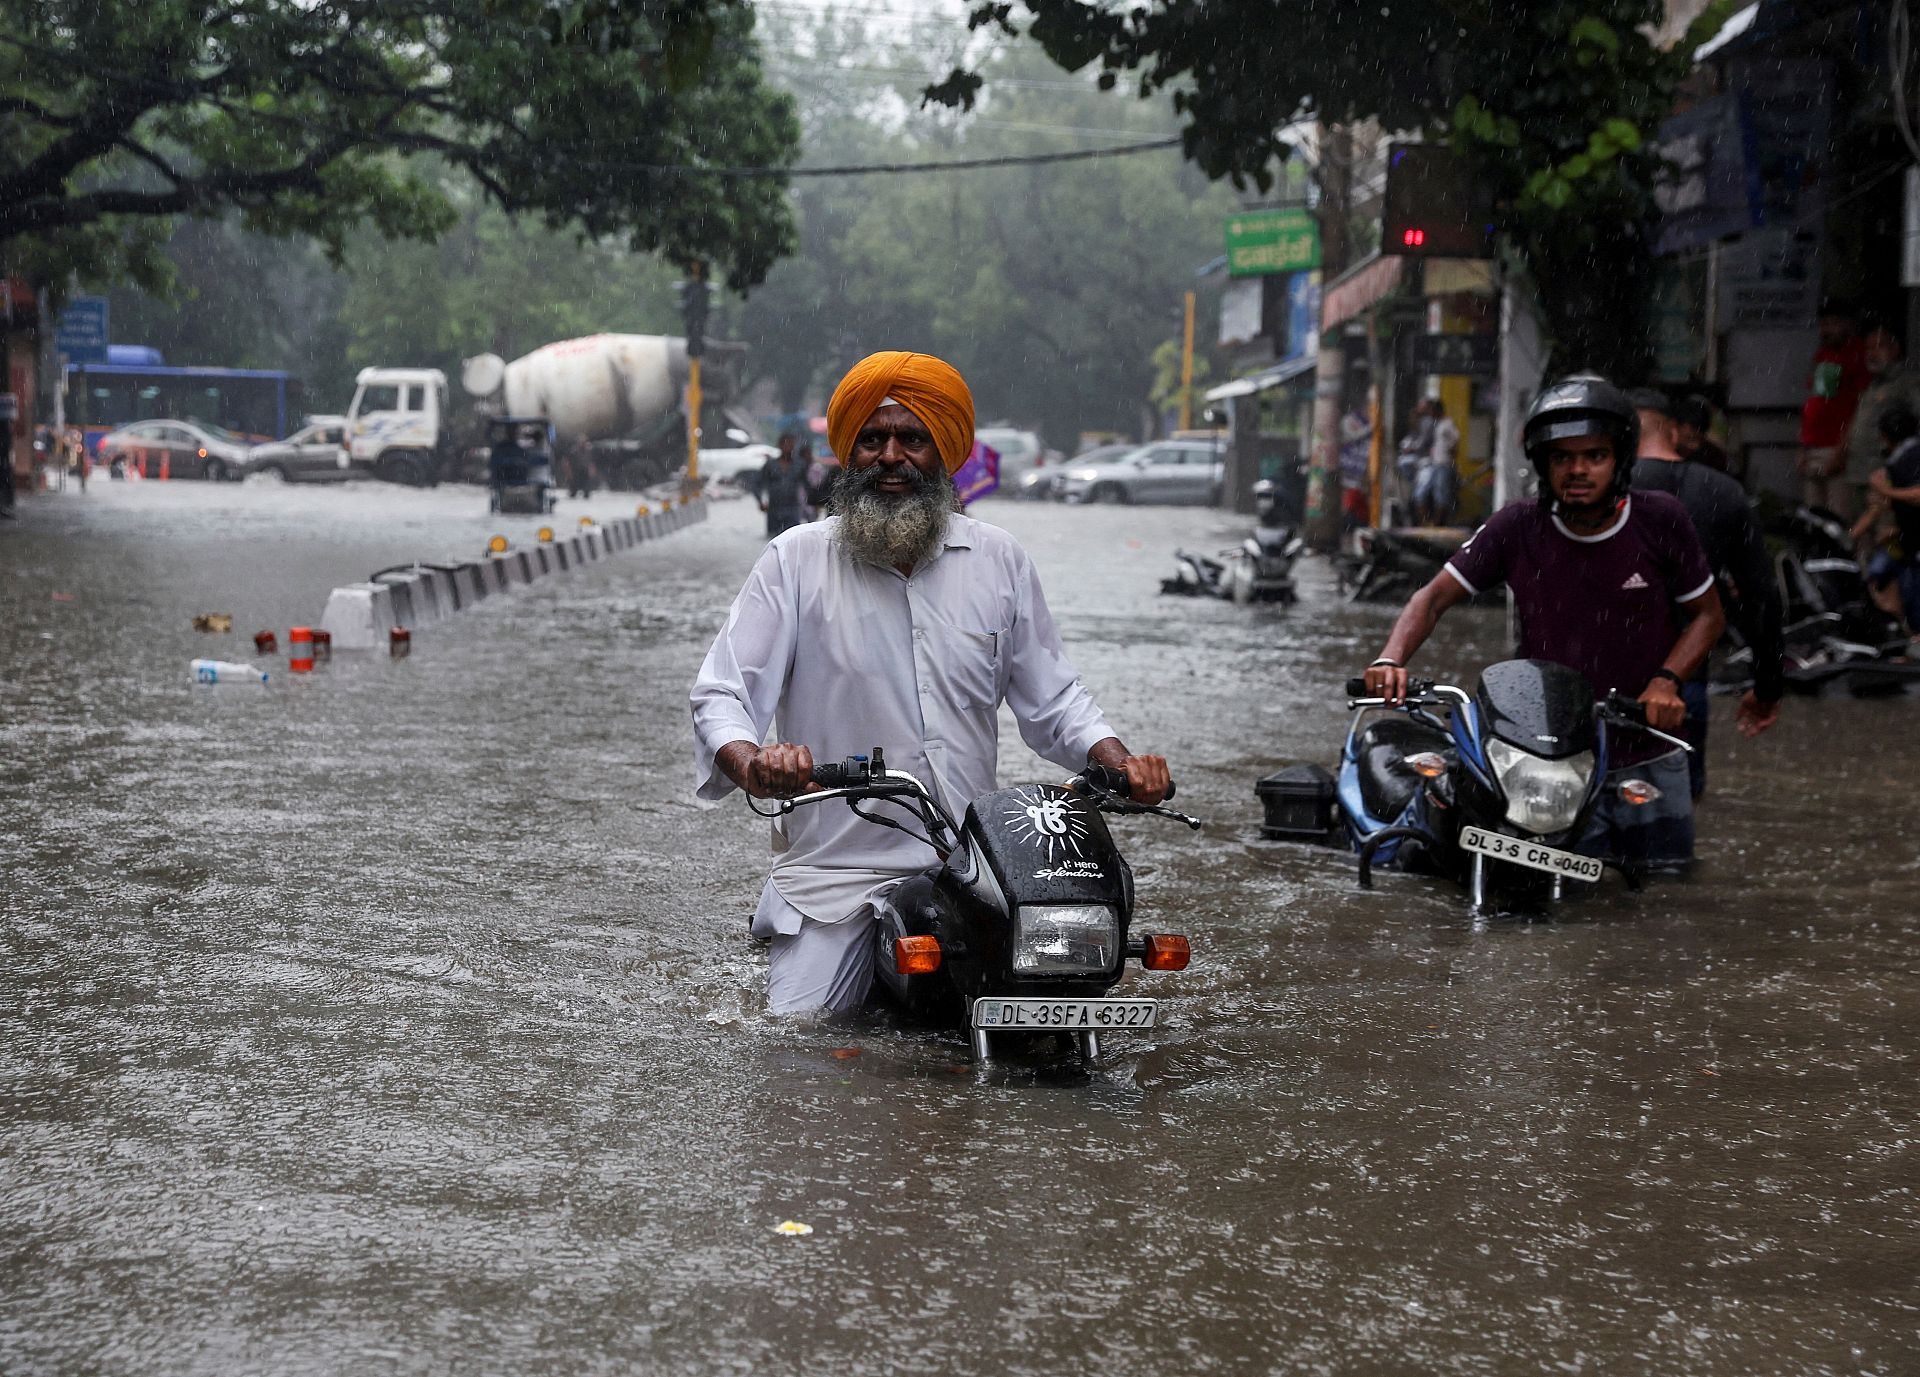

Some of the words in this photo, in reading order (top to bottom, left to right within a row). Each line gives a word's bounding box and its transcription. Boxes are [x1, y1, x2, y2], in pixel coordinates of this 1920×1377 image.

[1467, 832, 1488, 850] DL
[1527, 849, 1550, 866] CR
[1562, 857, 1600, 877] 0403
[1001, 1004, 1026, 1025] DL
[1037, 1004, 1089, 1025] 3SFA
[1101, 1005, 1153, 1026] 6327
